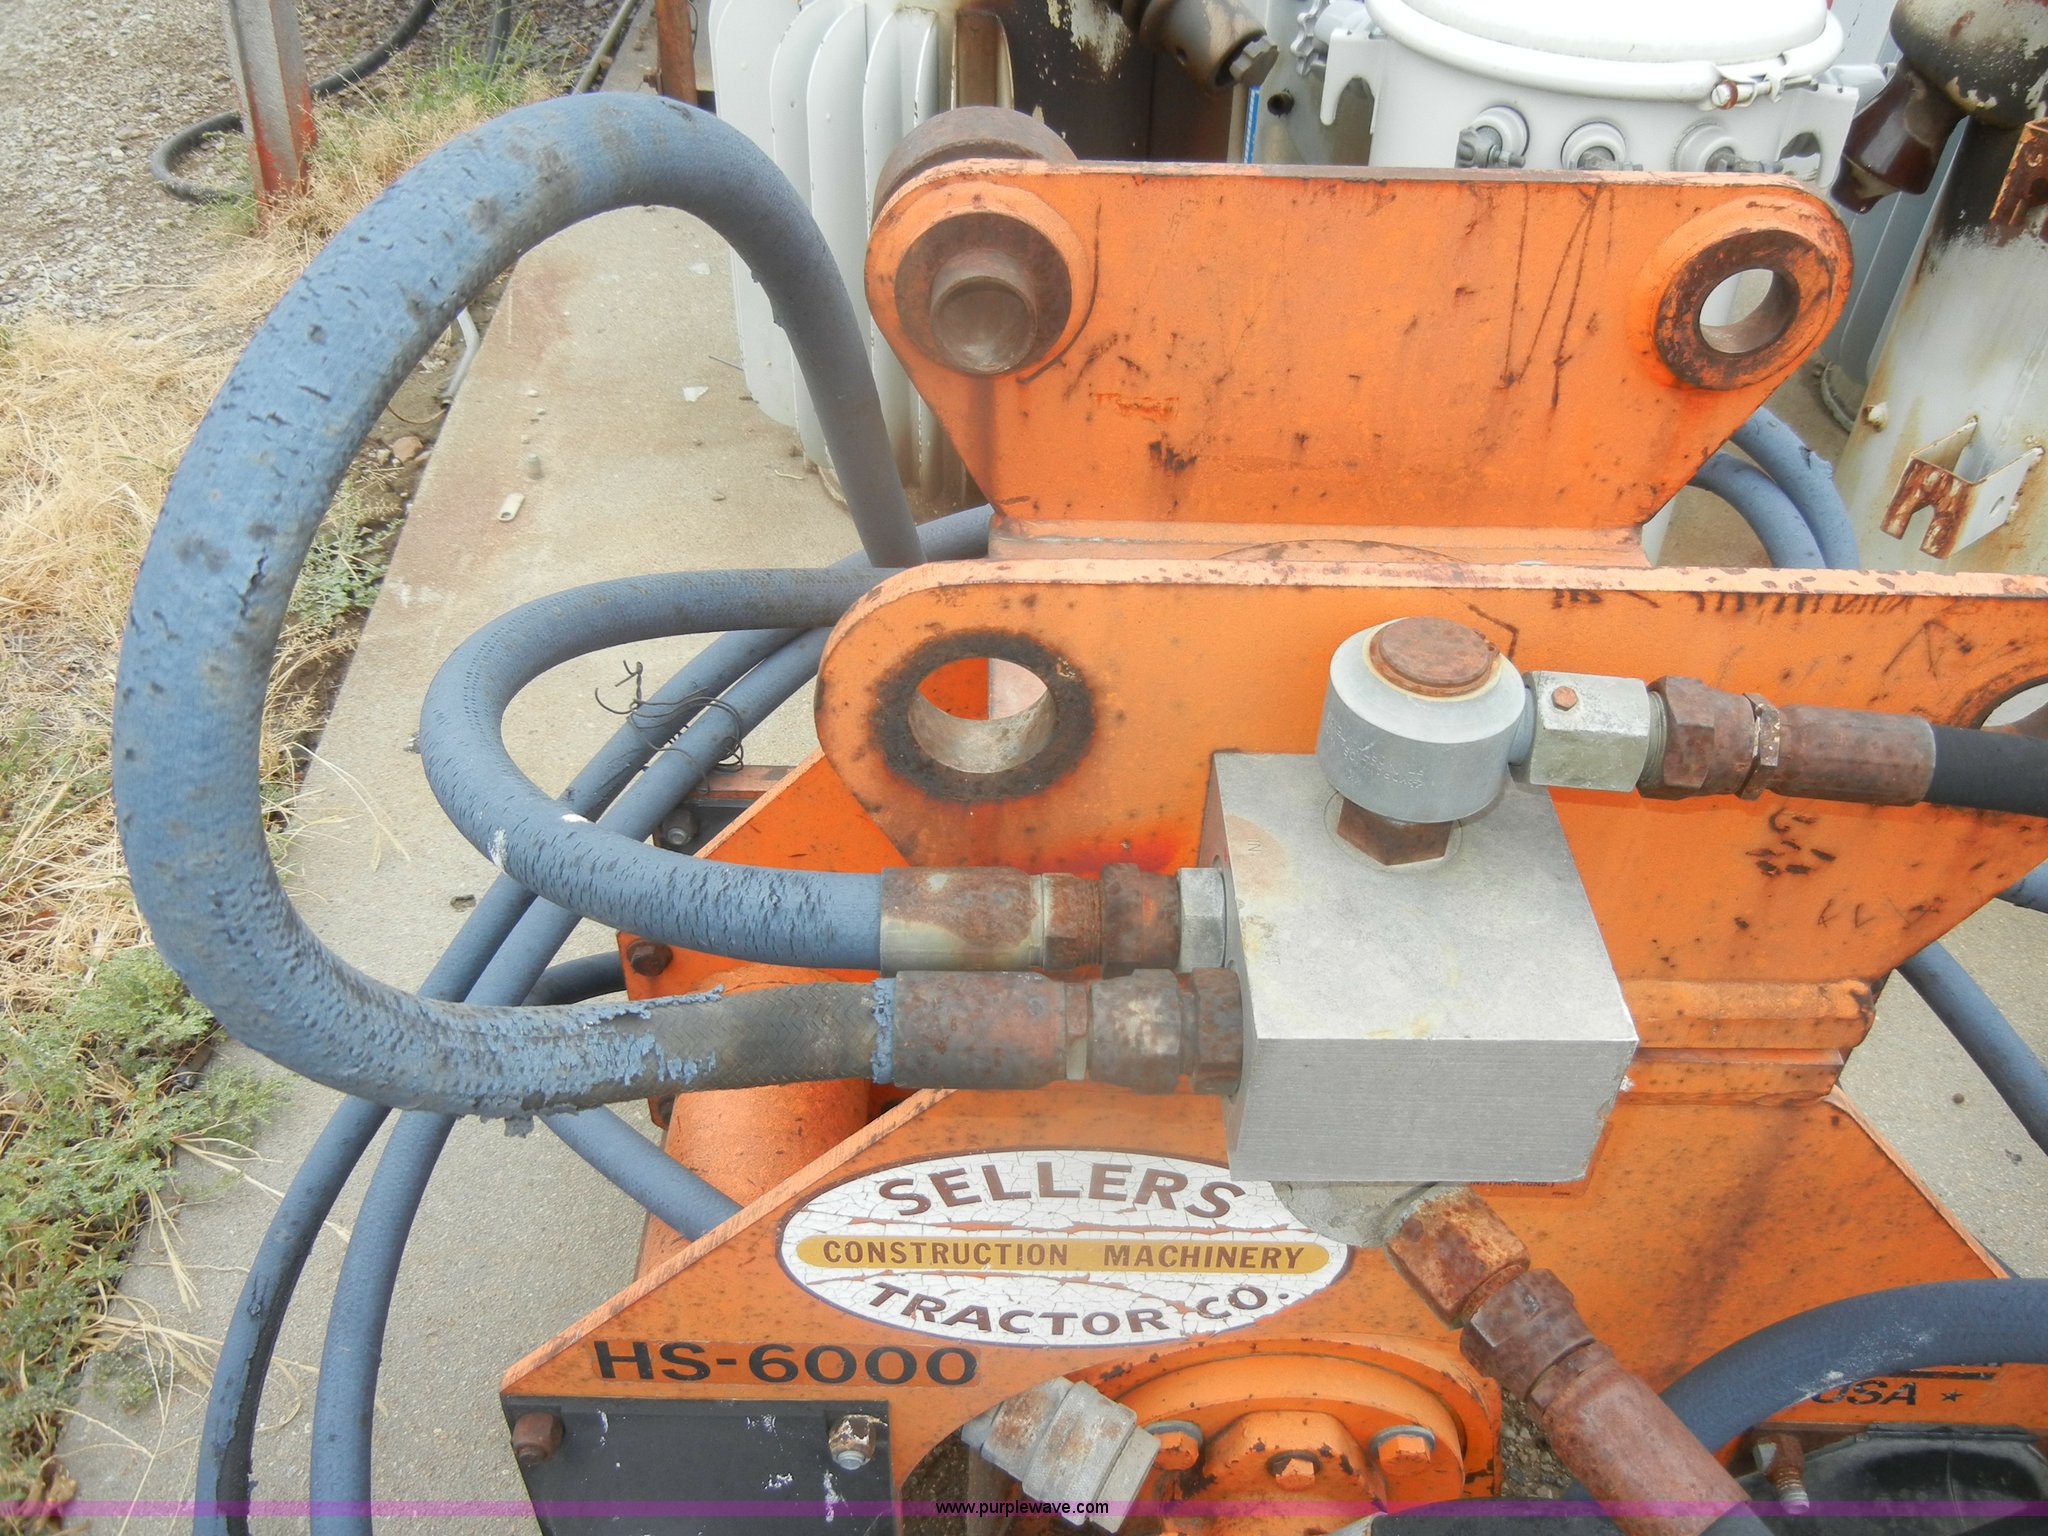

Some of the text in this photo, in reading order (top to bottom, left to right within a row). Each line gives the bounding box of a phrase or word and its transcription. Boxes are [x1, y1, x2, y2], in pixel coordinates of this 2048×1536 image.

[879, 1161, 1246, 1219] SELLERS
[822, 1240, 1306, 1270] CONSTRUCTION MACHINERY
[868, 1282, 1290, 1336] TRACTOR CO.
[593, 1340, 978, 1385] HS-6000
[1811, 1379, 1917, 1406] USA
